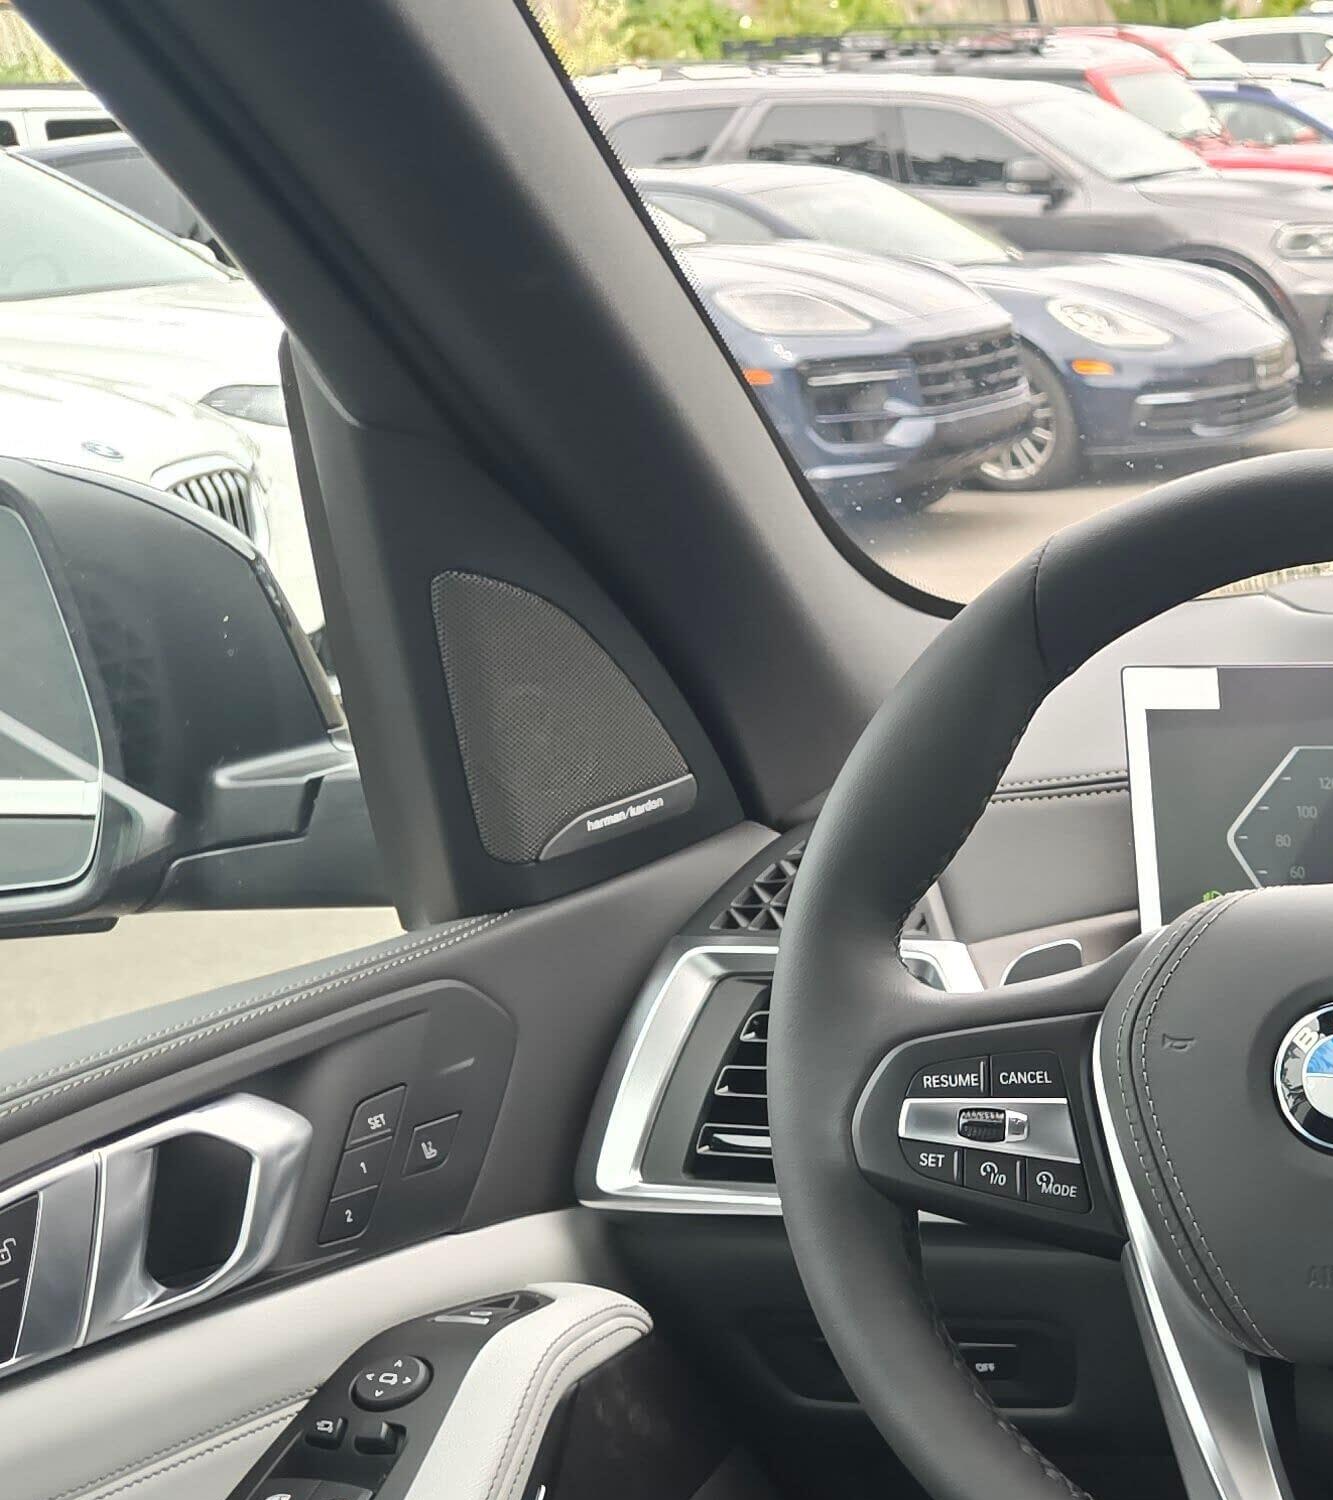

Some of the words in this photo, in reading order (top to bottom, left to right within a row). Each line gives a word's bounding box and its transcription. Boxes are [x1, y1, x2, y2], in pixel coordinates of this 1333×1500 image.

[1296, 805, 1318, 818] 100
[1290, 865, 1305, 879] 60
[923, 1072, 979, 1089] RESUME
[999, 1070, 1052, 1085] CANCEL
[367, 1113, 386, 1130] SET
[360, 1161, 368, 1174] 1
[919, 1152, 945, 1168] SET
[1041, 1181, 1077, 1198] MODE
[344, 1209, 353, 1223] 2
